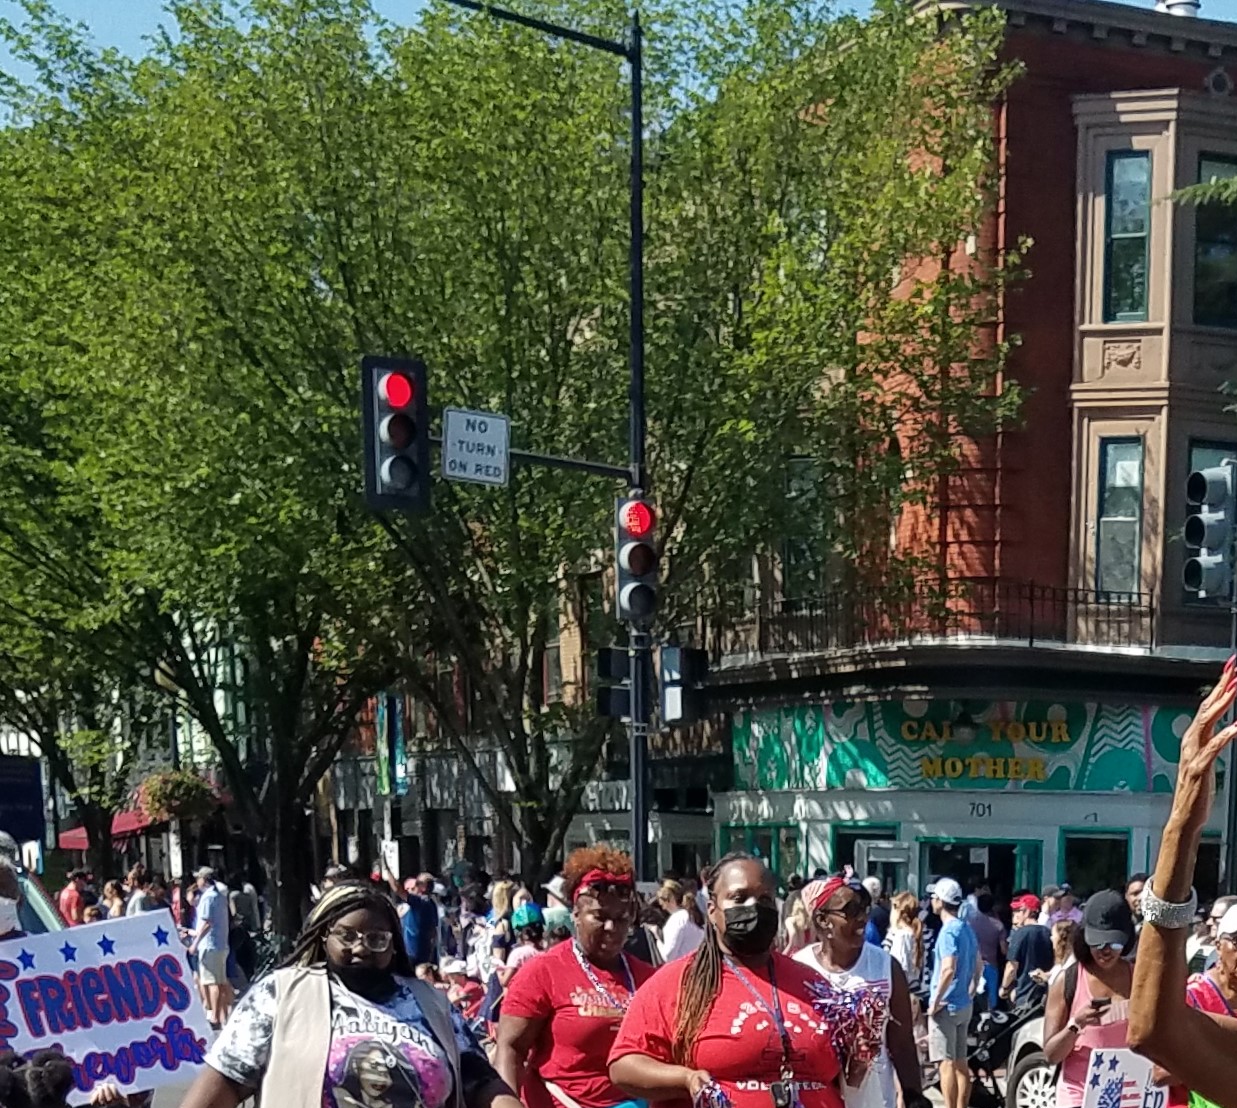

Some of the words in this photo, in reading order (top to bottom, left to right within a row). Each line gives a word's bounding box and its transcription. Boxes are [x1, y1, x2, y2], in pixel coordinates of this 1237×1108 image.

[465, 418, 489, 433] NO
[457, 439, 496, 457] TURN
[448, 459, 468, 473] ON
[474, 463, 502, 478] RED
[921, 756, 1047, 781] MOTHER
[968, 802, 992, 818] 701
